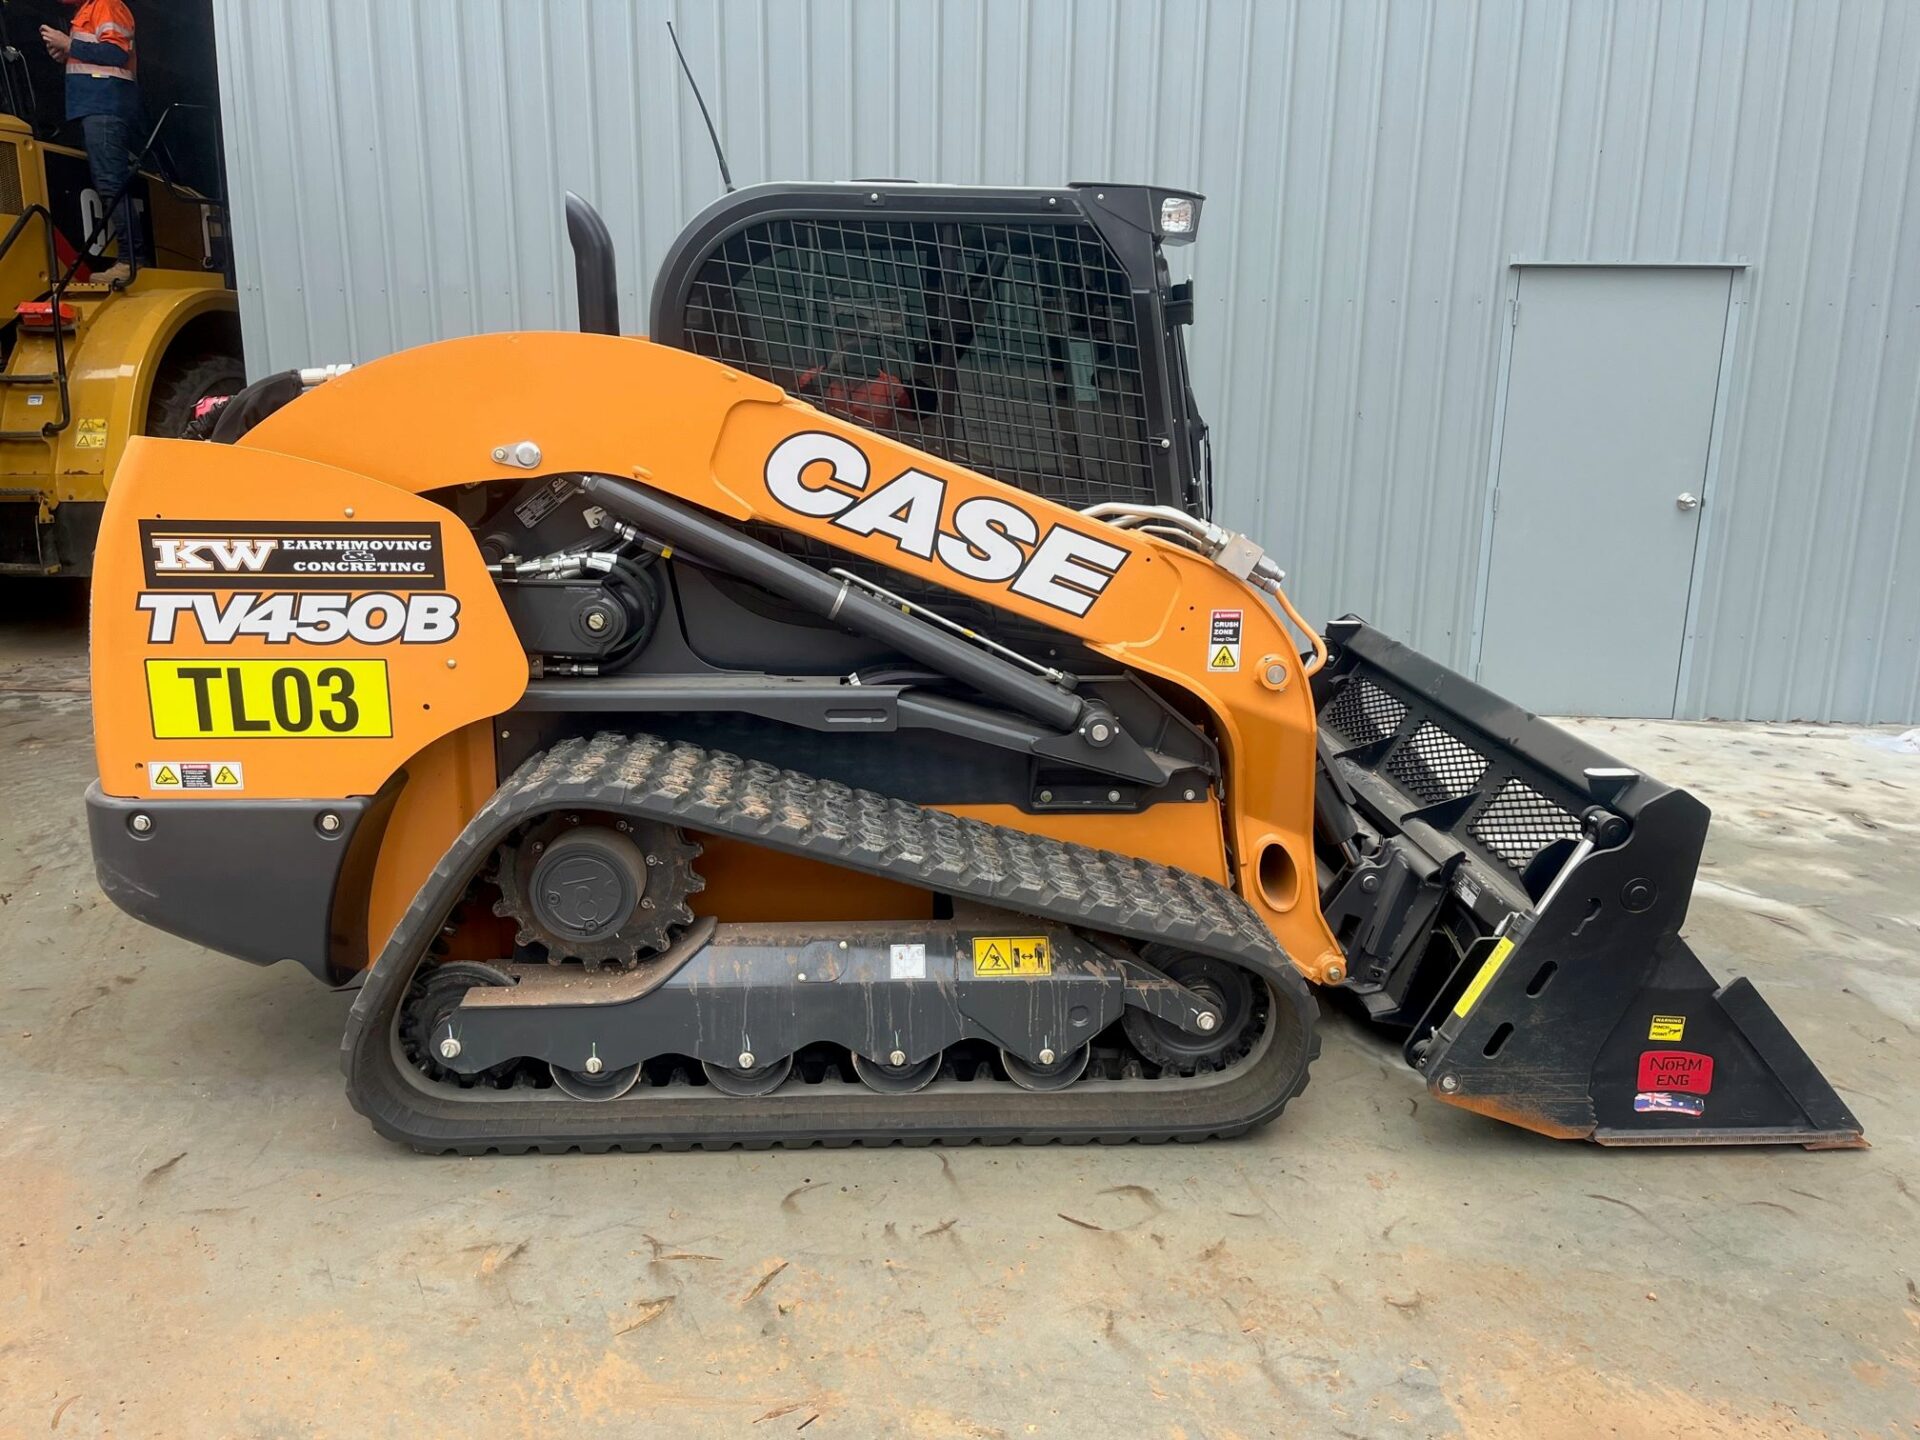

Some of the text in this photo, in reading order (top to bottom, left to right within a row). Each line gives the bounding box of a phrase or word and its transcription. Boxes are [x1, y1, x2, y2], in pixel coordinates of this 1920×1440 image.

[764, 430, 1132, 618] CASE
[151, 538, 278, 571] KW
[282, 540, 432, 552] EARTHMOVING
[342, 550, 376, 562] &
[293, 561, 426, 573] CONCRETING
[136, 591, 461, 645] TV450B
[177, 667, 359, 732] TL03
[1656, 1074, 1690, 1086] ENG
